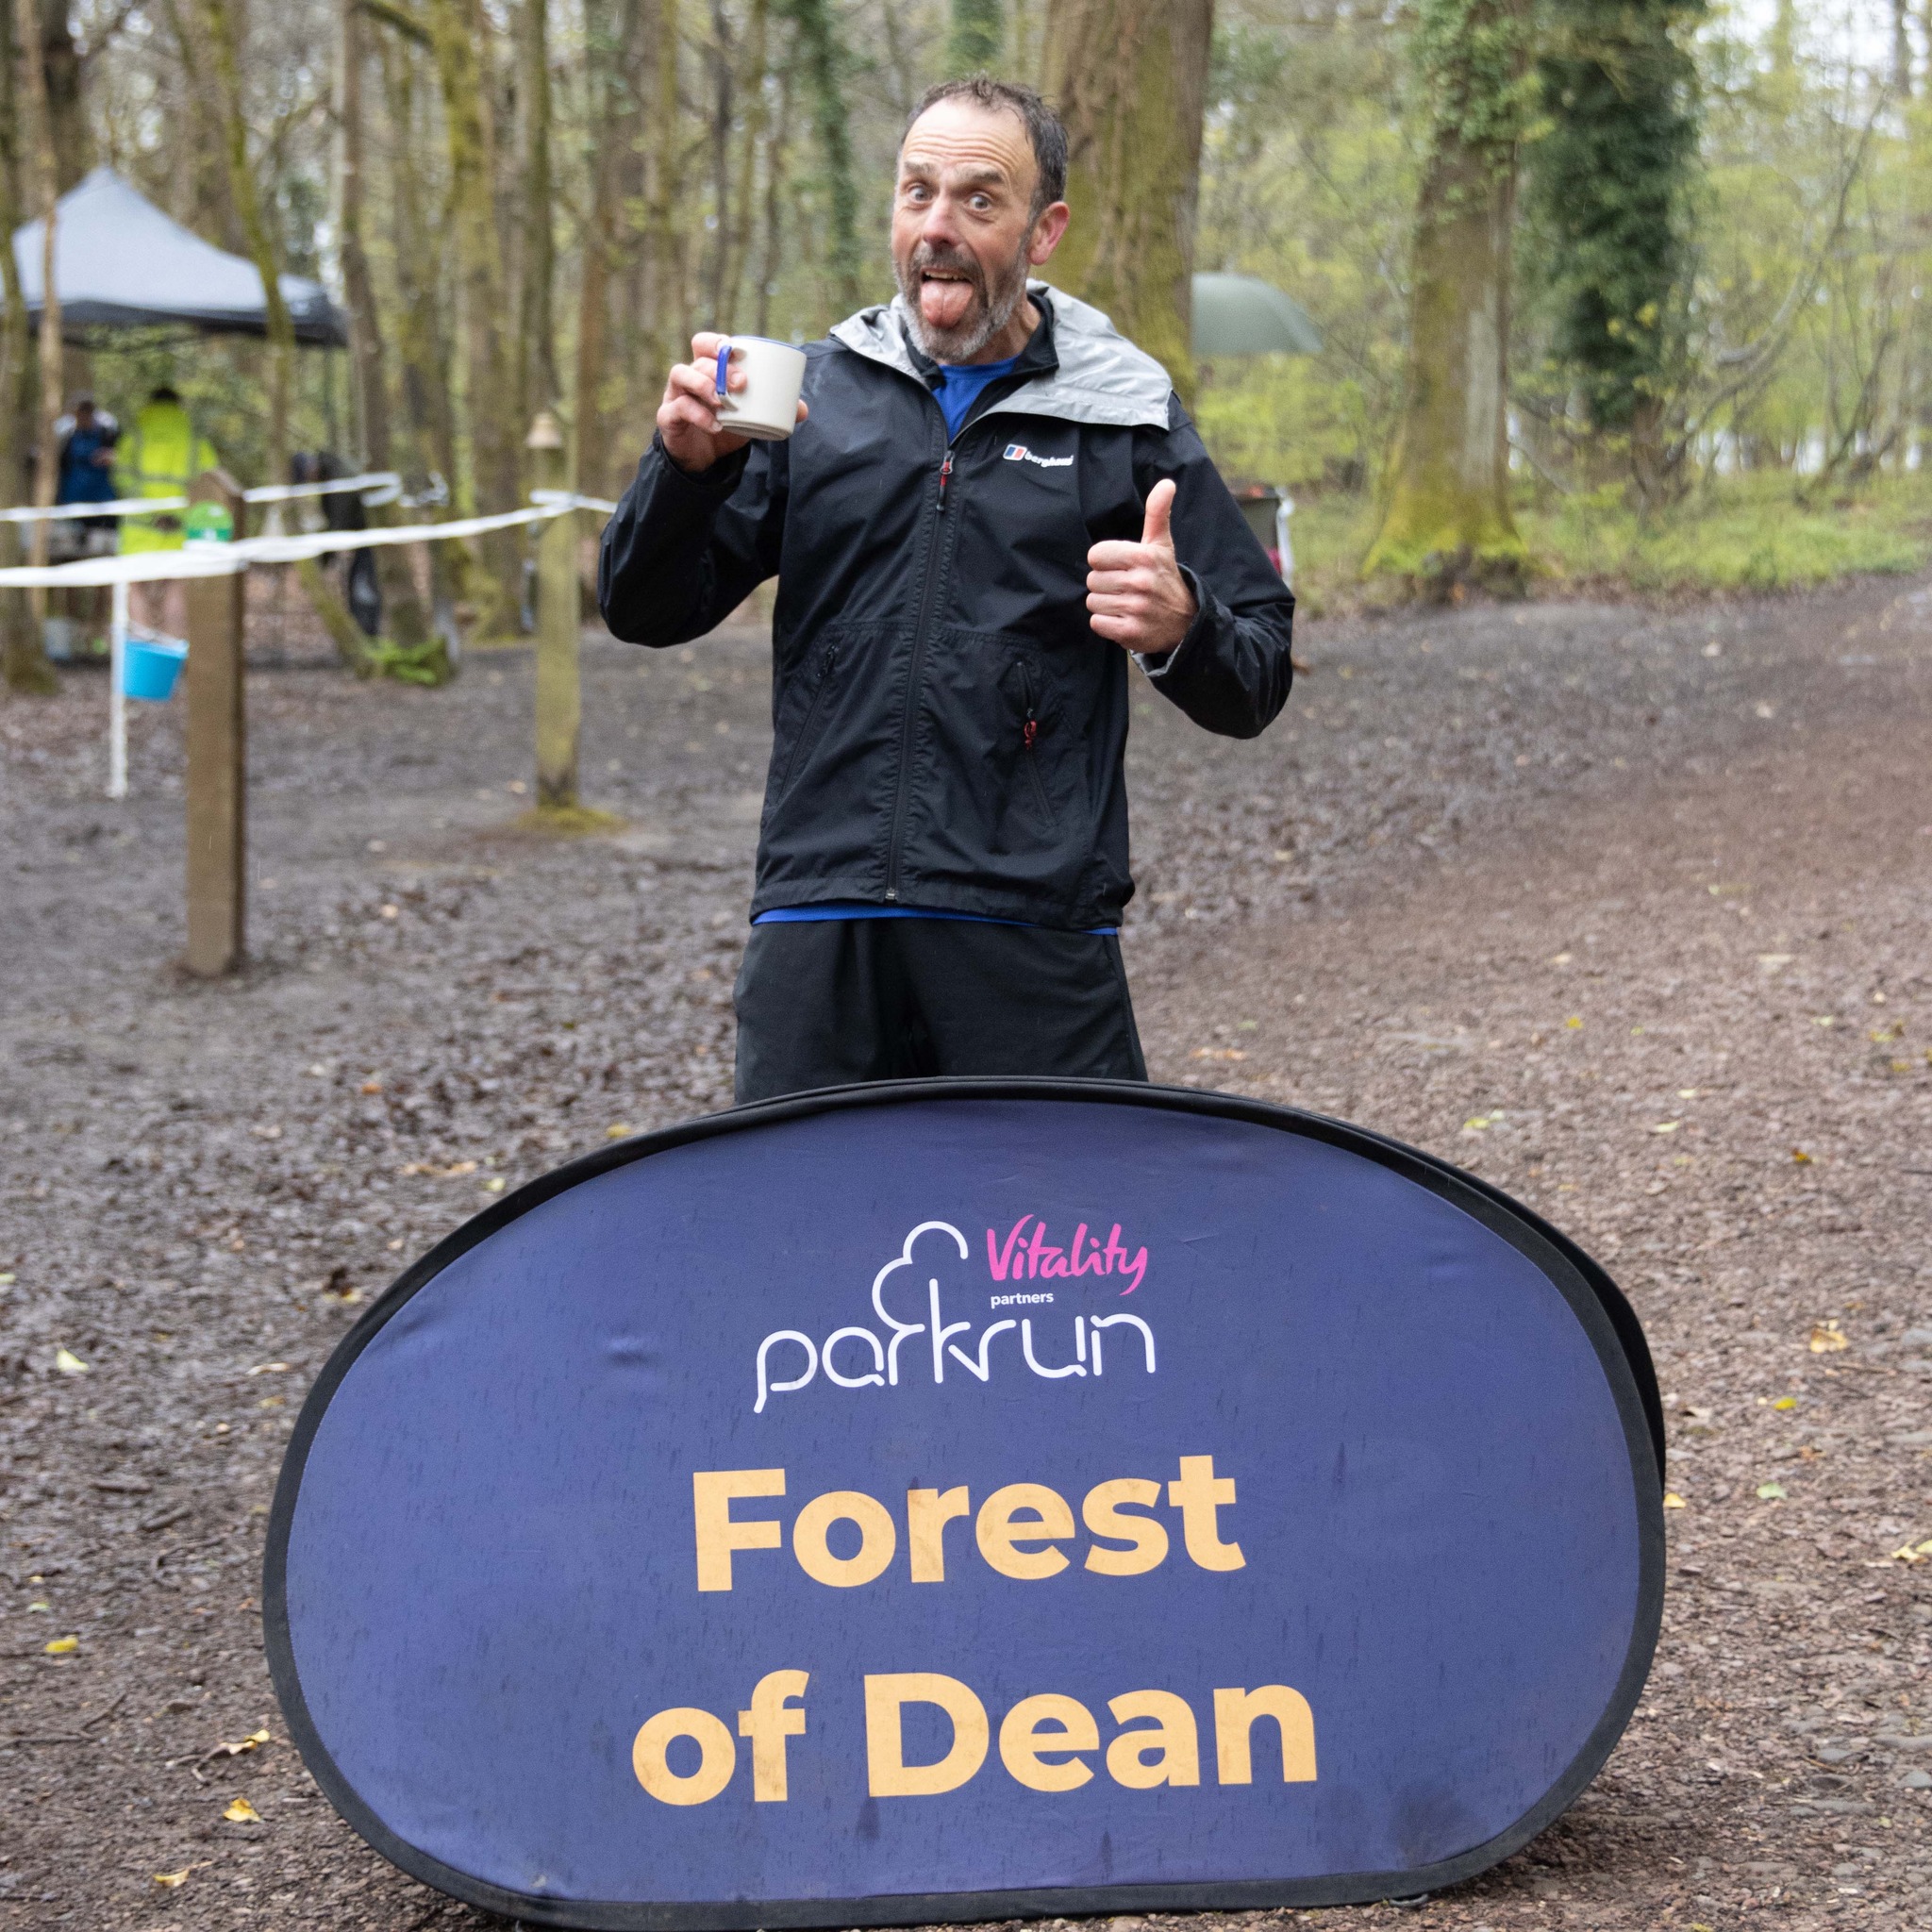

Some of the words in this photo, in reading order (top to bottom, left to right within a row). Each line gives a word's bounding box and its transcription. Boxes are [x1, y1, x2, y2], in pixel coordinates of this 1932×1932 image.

[986, 1214, 1148, 1296] Vitality
[990, 1292, 1055, 1309] partners
[753, 1278, 1157, 1414] parkrun
[692, 1455, 1246, 1591] Forest
[632, 1669, 809, 1806] of
[864, 1673, 1317, 1797] Dean
